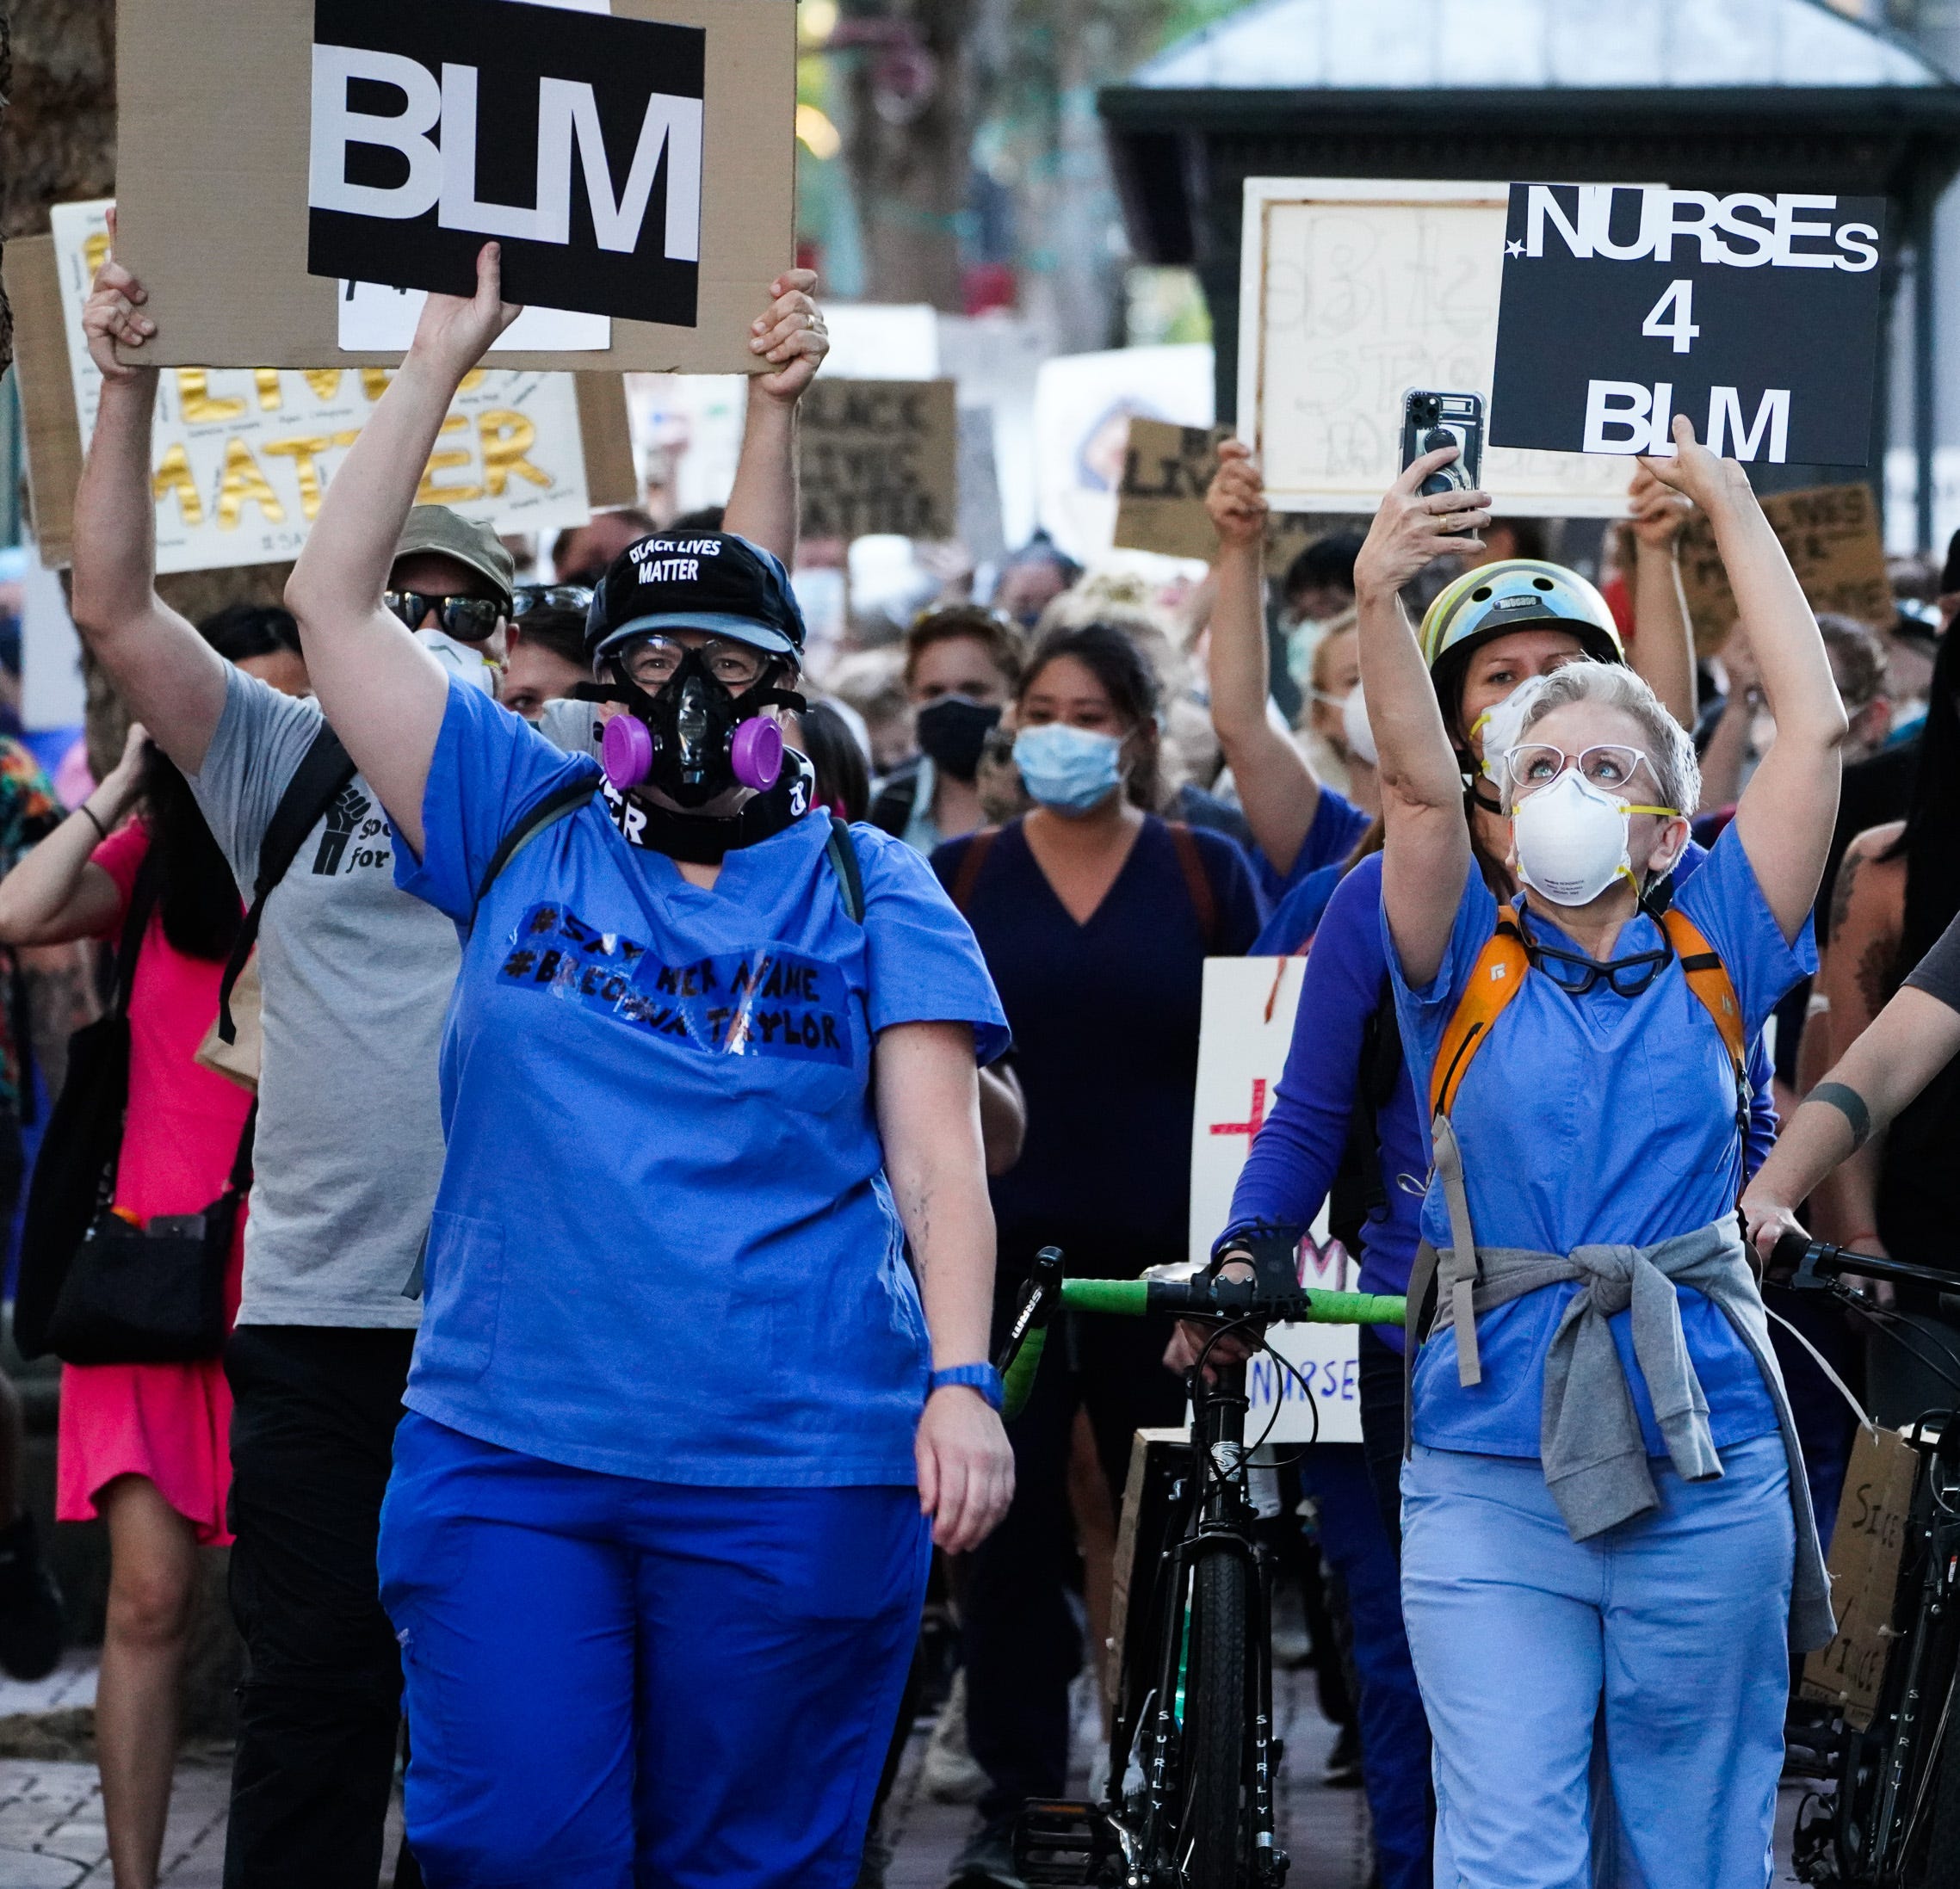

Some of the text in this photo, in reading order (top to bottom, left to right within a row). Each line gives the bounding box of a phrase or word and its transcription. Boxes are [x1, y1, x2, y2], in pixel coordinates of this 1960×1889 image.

[308, 43, 702, 262] BLM
[1642, 279, 1700, 354] 4
[1582, 379, 1790, 464] BLM
[152, 408, 553, 530] MATER
[629, 540, 721, 564] BLACK LIVES
[639, 559, 699, 584] MATTER
[345, 847, 390, 874] for
[731, 955, 820, 1003] NAME
[1011, 1286, 1042, 1339] SRAM
[1151, 1709, 1170, 1810] SURLY
[1255, 1713, 1268, 1815] SURLY
[1891, 1688, 1920, 1791] SURLY
